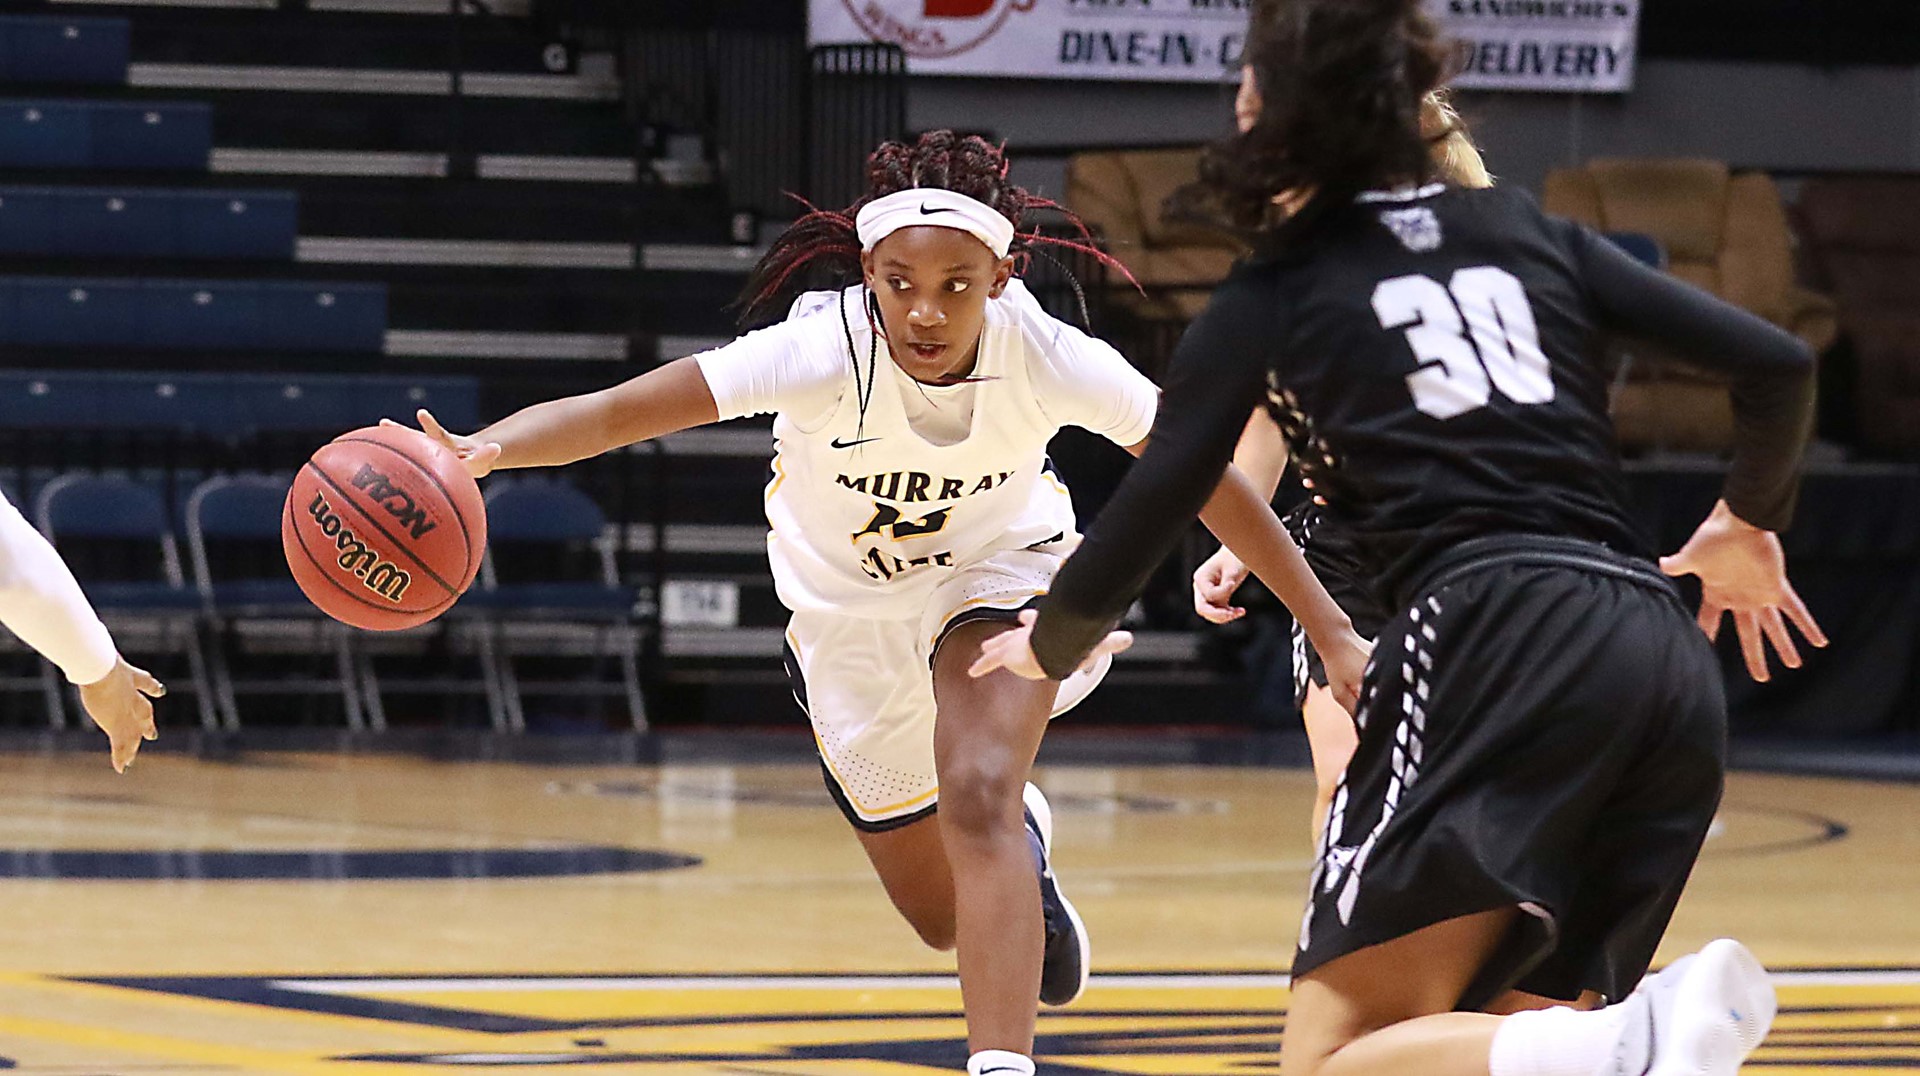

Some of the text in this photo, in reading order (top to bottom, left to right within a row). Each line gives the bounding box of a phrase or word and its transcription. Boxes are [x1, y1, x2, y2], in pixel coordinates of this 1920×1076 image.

[1370, 266, 1556, 420] 30
[351, 463, 436, 540] NCAA
[835, 470, 1016, 503] MURRAY
[307, 489, 412, 602] Wilson
